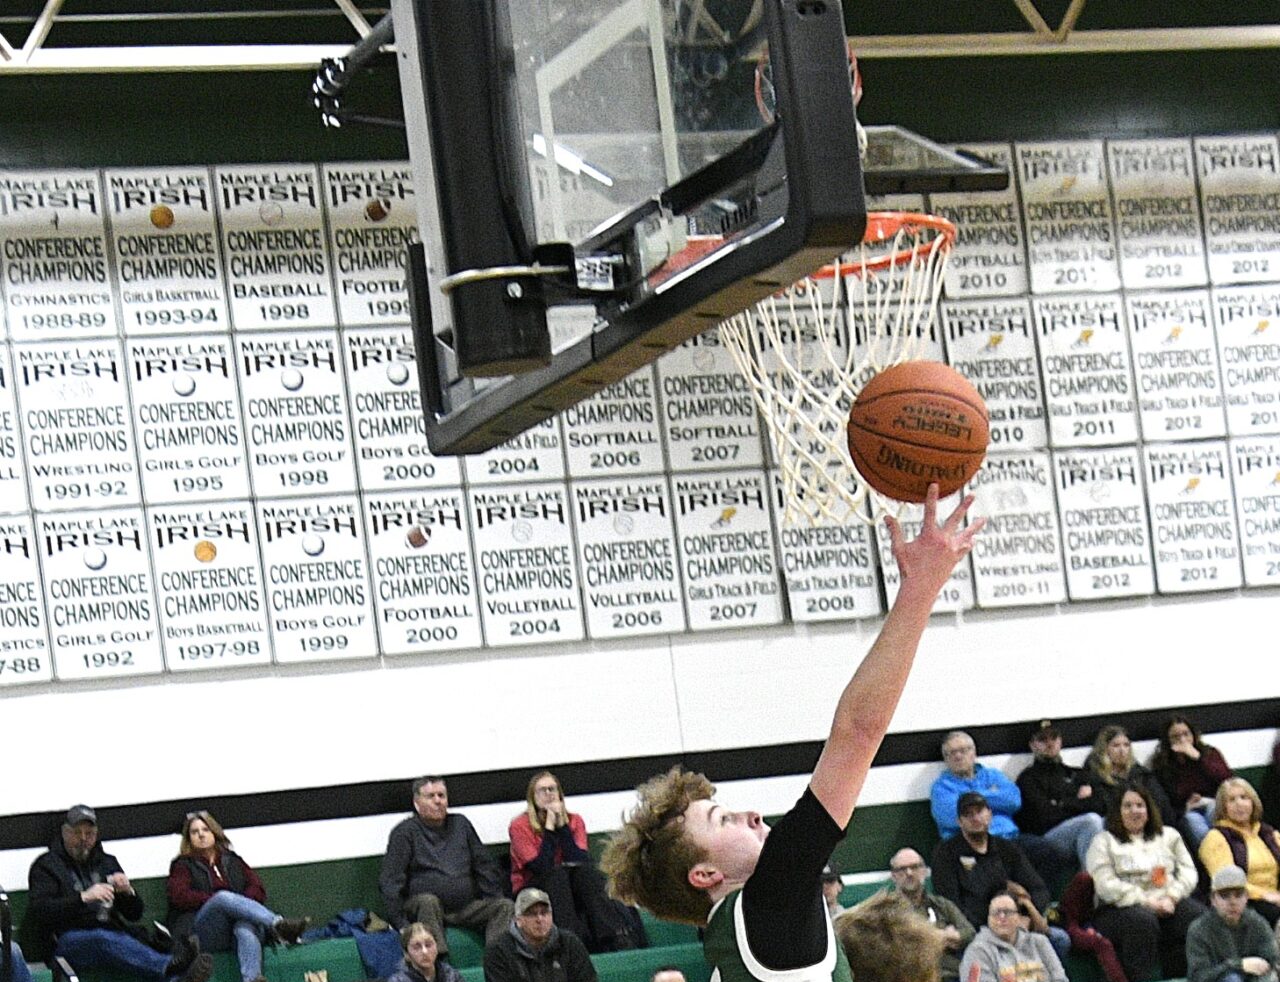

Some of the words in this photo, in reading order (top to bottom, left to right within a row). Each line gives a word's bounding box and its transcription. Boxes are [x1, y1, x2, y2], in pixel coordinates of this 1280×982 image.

[221, 174, 269, 188] MAPLE
[275, 171, 315, 186] LAKE
[113, 187, 208, 213] IRISH
[223, 185, 316, 209] IRISH
[5, 236, 103, 259] CONFERENCE
[118, 233, 215, 257] CONFERENCE
[228, 229, 322, 252] CONFERENCE
[8, 260, 106, 284] CHAMPIONS
[121, 255, 217, 283] CHAMPIONS
[231, 252, 325, 277] CHAMPIONS
[233, 283, 327, 298] BASEBALL
[960, 273, 1007, 288] 2010
[21, 313, 106, 329] 1988-89
[135, 309, 219, 326] 1993-94
[260, 305, 310, 320] 1998
[1042, 310, 1119, 334] IRISH
[949, 317, 1028, 341] IRISH
[23, 360, 118, 386] IRISH
[135, 355, 228, 381] IRISH
[245, 349, 336, 376] IRISH
[1046, 352, 1124, 374] CONFERENCE
[665, 371, 749, 396] CONFERENCE
[1050, 372, 1128, 395] CHAMPIONS
[28, 406, 124, 429] CONFERENCE
[139, 400, 234, 424] CONFERENCE
[248, 395, 342, 418] CONFERENCE
[567, 403, 653, 427] CHAMPIONS
[667, 397, 753, 422] CHAMPIONS
[143, 425, 238, 449] CHAMPIONS
[252, 420, 344, 445] CHAMPIONS
[569, 431, 657, 448] SOFTBALL
[670, 425, 758, 442] SOFTBALL
[1073, 420, 1115, 436] 2011
[30, 431, 127, 456] CHAMPIONS
[361, 446, 402, 459] BOYS
[692, 445, 740, 462] 2007
[146, 458, 195, 471] GIRLS
[199, 455, 242, 468] GOLF
[256, 452, 298, 466] BOYS
[303, 449, 345, 463] GOLF
[488, 457, 539, 475] 2004
[591, 451, 640, 468] 2006
[34, 462, 133, 477] WRESTLING
[279, 471, 329, 487] 1998
[383, 465, 435, 480] 2000
[1062, 464, 1136, 489] IRISH
[45, 482, 128, 499] 1991-92
[173, 476, 223, 493] 1995
[677, 480, 723, 491] MAPLE
[726, 477, 761, 488] LAKE
[579, 495, 665, 522] IRISH
[679, 489, 764, 515] IRISH
[373, 508, 462, 536] IRISH
[478, 503, 565, 528] IRISH
[1065, 506, 1140, 527] CONFERENCE
[156, 522, 250, 549] IRISH
[266, 516, 358, 543] IRISH
[782, 524, 866, 548] CONFERENCE
[1067, 528, 1144, 551] CHAMPIONS
[46, 529, 142, 556] IRISH
[583, 538, 671, 562] CONFERENCE
[684, 531, 770, 555] CONFERENCE
[977, 532, 1055, 557] CHAMPIONS
[377, 552, 468, 576] CONFERENCE
[481, 546, 570, 569] CONFERENCE
[687, 555, 772, 580] CHAMPIONS
[785, 547, 869, 572] CHAMPIONS
[1071, 554, 1148, 571] BASEBALL
[162, 567, 256, 591] CONFERENCE
[270, 560, 362, 585] CONFERENCE
[484, 569, 572, 594] CHAMPIONS
[587, 561, 674, 586] CHAMPIONS
[1092, 574, 1131, 589] 2012
[51, 574, 148, 598] CONFERENCE
[380, 576, 470, 601] CHAMPIONS
[165, 591, 259, 618] CHAMPIONS
[272, 585, 365, 611] CHAMPIONS
[487, 598, 576, 615] VOLLEYBALL
[590, 590, 678, 608] VOLLEYBALL
[807, 596, 854, 612] 2008
[54, 600, 150, 626] CHAMPIONS
[276, 618, 319, 632] BOYS
[323, 615, 365, 629] GOLF
[384, 605, 473, 622] FOOTBALL
[613, 611, 662, 628] 2006
[710, 604, 757, 620] 2007
[166, 626, 195, 639] BOYS
[197, 622, 264, 635] BASKETBALL
[407, 626, 458, 643] 2000
[510, 619, 561, 635] 2004
[57, 633, 106, 648] GIRLS
[111, 630, 154, 644] GOLF
[178, 641, 260, 660] 1997-98
[299, 636, 349, 652] 1999
[83, 652, 134, 668] 1992
